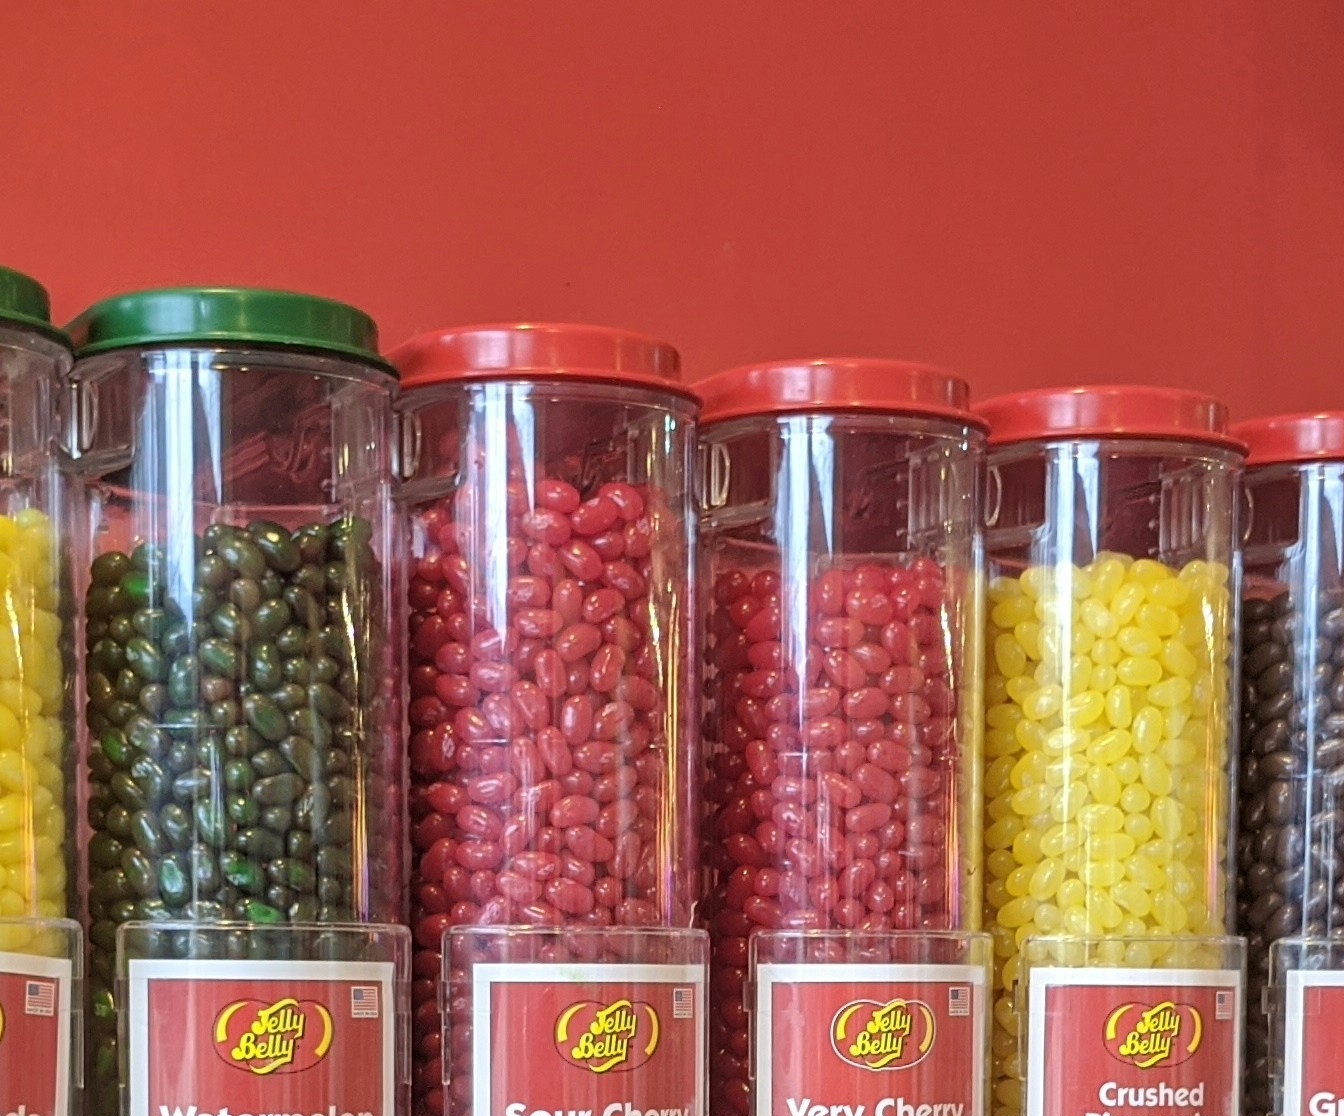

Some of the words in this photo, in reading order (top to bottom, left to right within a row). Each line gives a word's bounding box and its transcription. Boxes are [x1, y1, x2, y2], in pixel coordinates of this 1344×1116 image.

[251, 998, 304, 1038] Jelly
[590, 1000, 637, 1038] Jelly
[867, 1000, 911, 1036] Jelly
[1136, 1001, 1180, 1036] Jelly
[231, 1032, 294, 1074] Belly
[572, 1033, 628, 1073] Belly
[849, 1031, 903, 1069] Belly
[1119, 1031, 1173, 1068] Belly
[1098, 1081, 1204, 1107] Crushed
